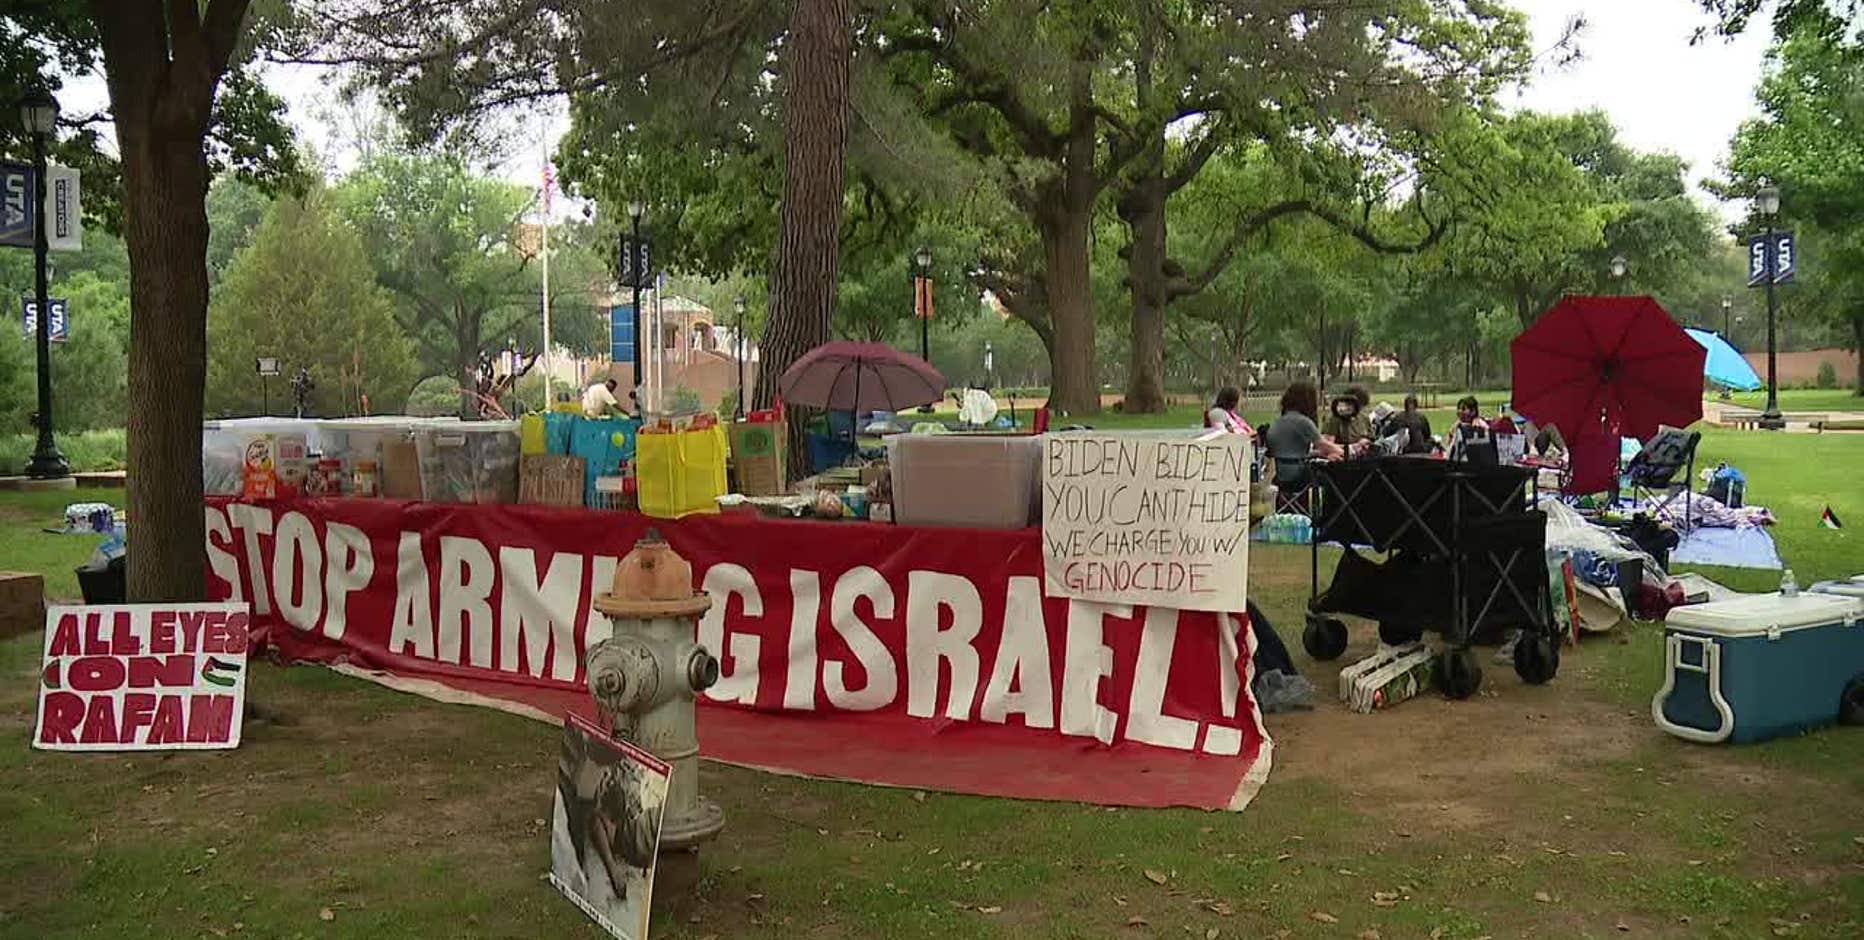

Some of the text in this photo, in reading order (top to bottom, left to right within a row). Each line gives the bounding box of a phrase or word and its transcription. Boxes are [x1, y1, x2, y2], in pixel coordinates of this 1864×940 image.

[6, 174, 24, 228] UTA
[1753, 242, 1764, 276] UTA
[1779, 238, 1790, 272] UTA
[52, 303, 64, 334] UTA
[1049, 439, 1244, 482] BIDEN BIDEN
[1046, 483, 1106, 525] YOU
[1188, 488, 1247, 523] HIDE
[1045, 529, 1085, 558] WE
[1088, 529, 1173, 556] CHARGE
[1178, 528, 1206, 557] YOU
[1064, 561, 1218, 594] GENOCIDE
[48, 611, 249, 655] ALL EYES
[204, 503, 375, 641] STOP
[783, 565, 1243, 757] ISRAEL!
[68, 654, 195, 691] ON
[40, 691, 234, 744] RAFAH
